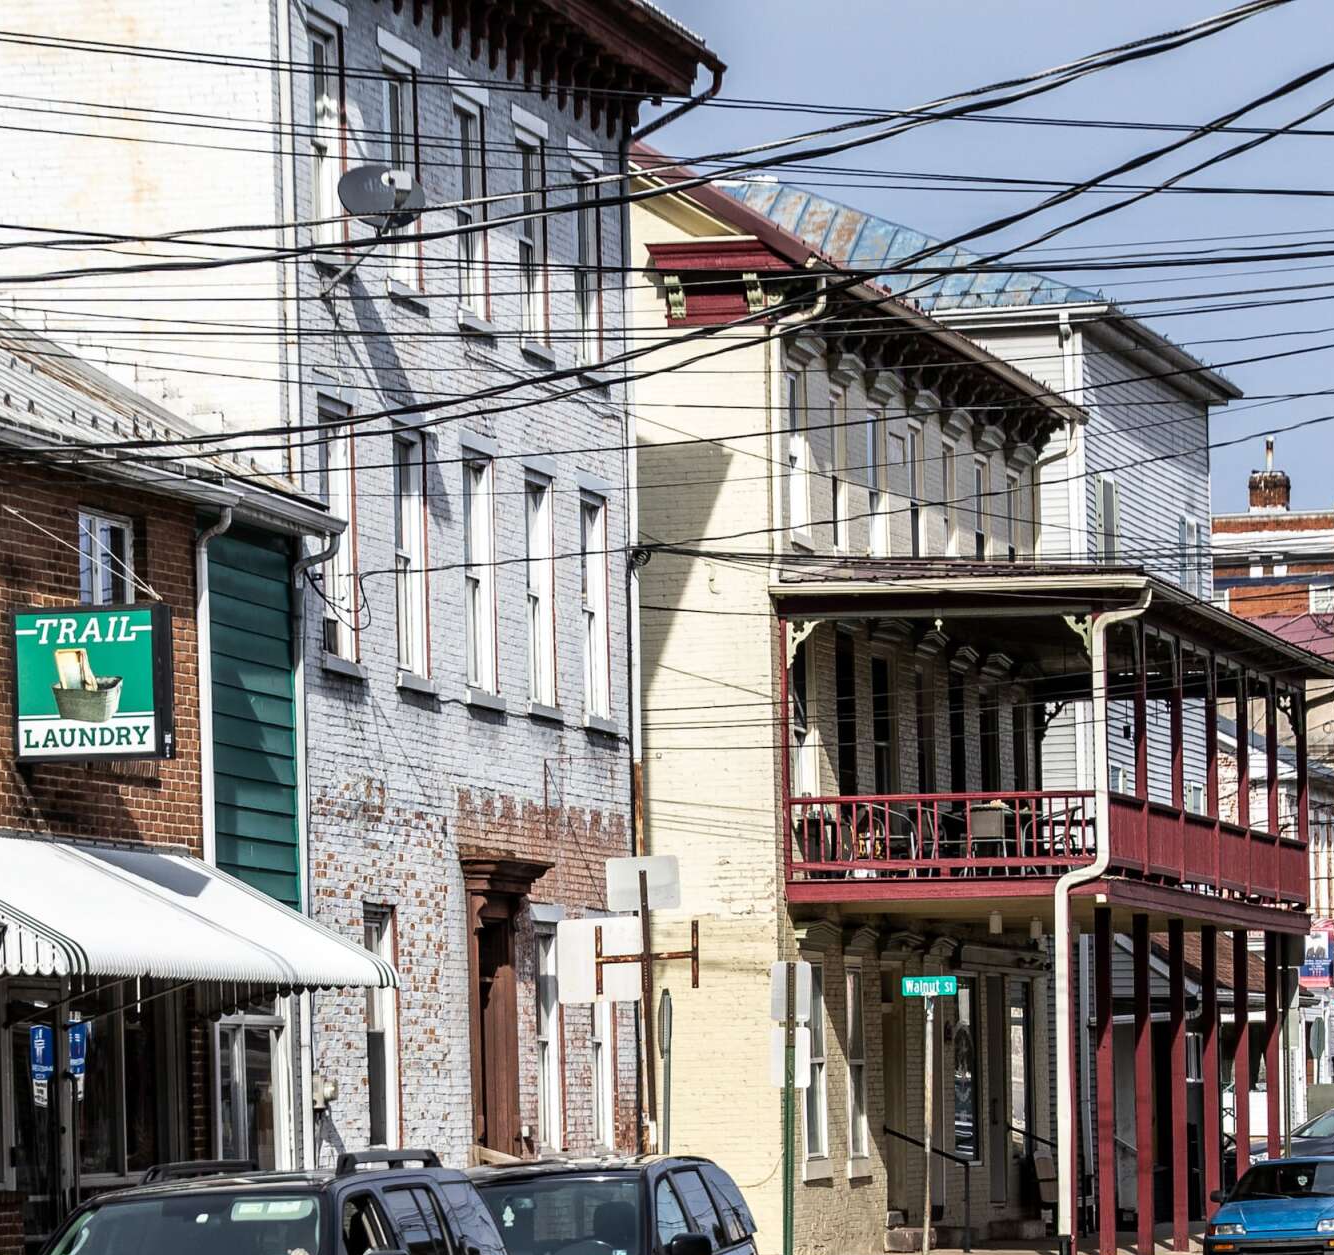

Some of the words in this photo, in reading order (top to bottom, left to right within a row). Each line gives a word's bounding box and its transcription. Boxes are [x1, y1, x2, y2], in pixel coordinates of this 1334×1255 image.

[34, 616, 137, 645] TRAIL
[24, 725, 151, 749] LAUNDRY
[906, 980, 940, 992] Walnut
